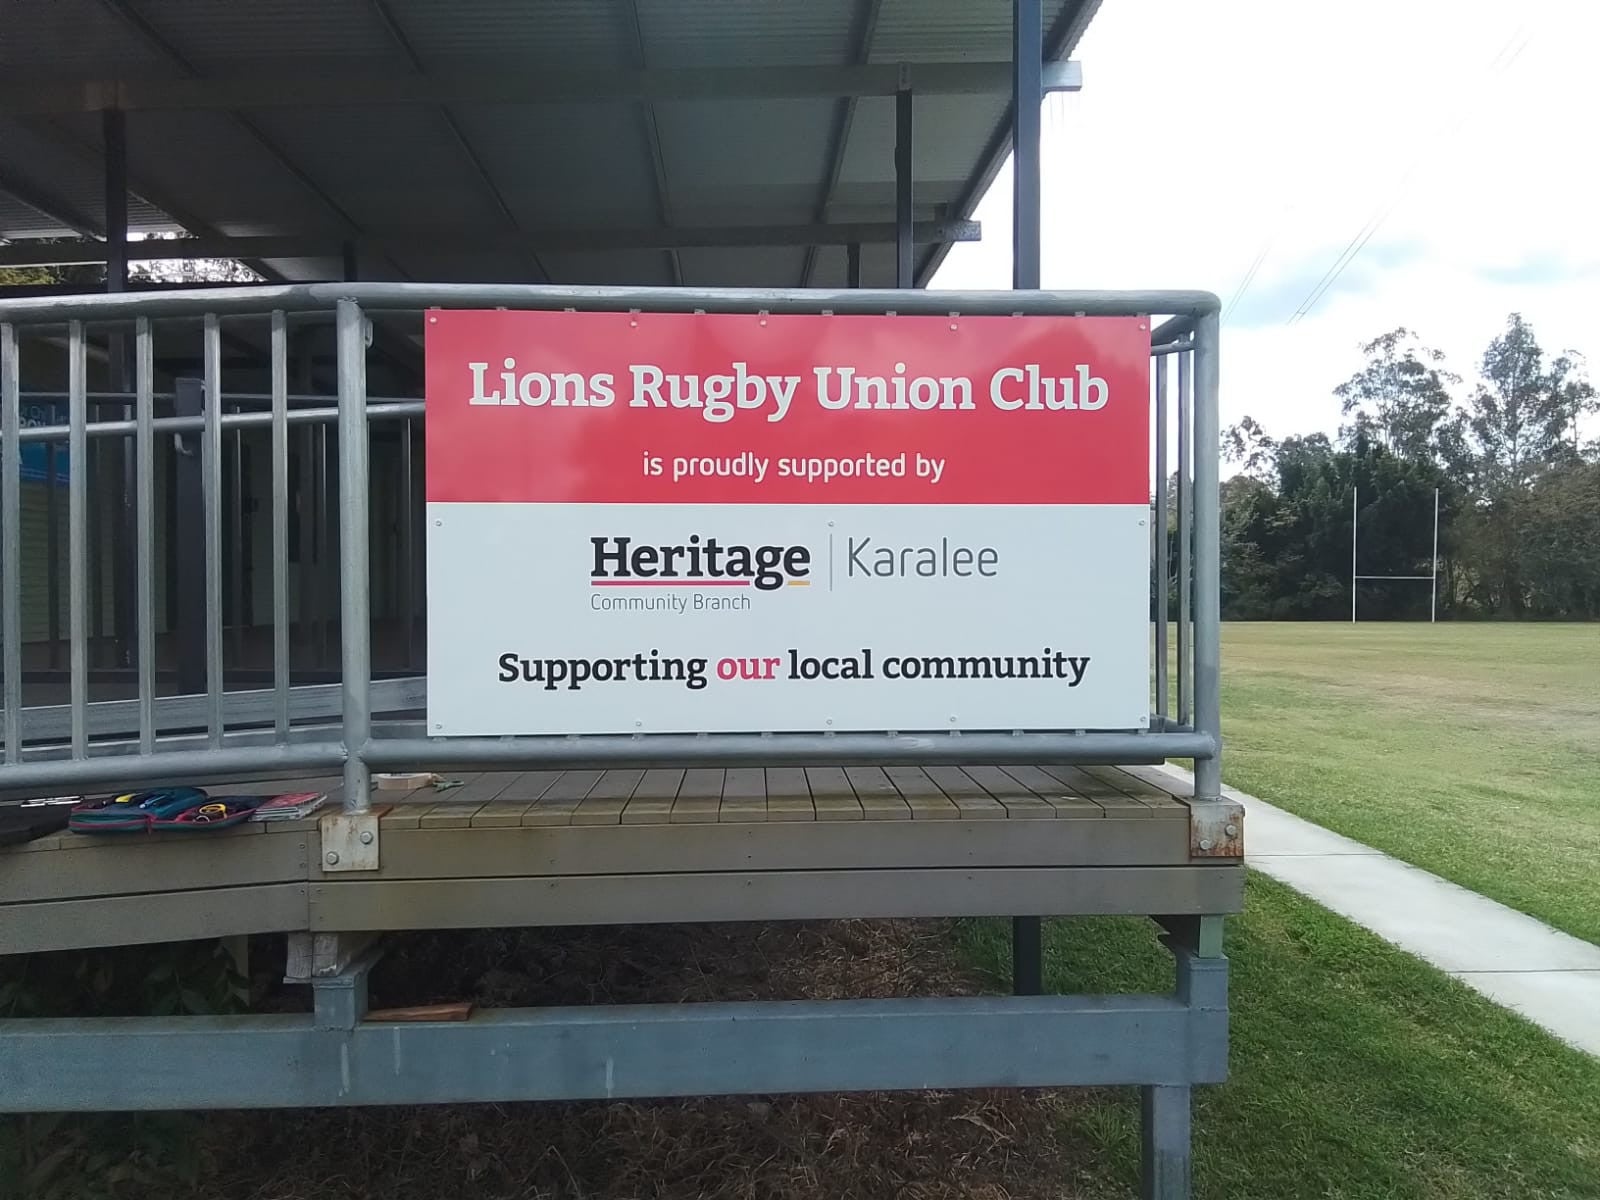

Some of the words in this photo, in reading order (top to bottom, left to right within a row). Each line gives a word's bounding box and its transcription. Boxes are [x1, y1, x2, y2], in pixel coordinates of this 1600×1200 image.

[468, 357, 616, 408] Lions
[628, 362, 802, 423] Rugby
[813, 361, 976, 411] Union
[989, 364, 1109, 412] Club
[642, 451, 663, 477] is
[672, 451, 769, 483] proudly
[777, 452, 907, 484] supported
[915, 452, 946, 485] by
[590, 534, 811, 590] Heritage
[848, 536, 1000, 578] Karalee
[590, 593, 688, 615] Community
[693, 592, 752, 611] Branch
[498, 648, 709, 691] Supporting
[716, 656, 781, 682] our
[787, 648, 875, 680] local
[882, 647, 1092, 688] community
